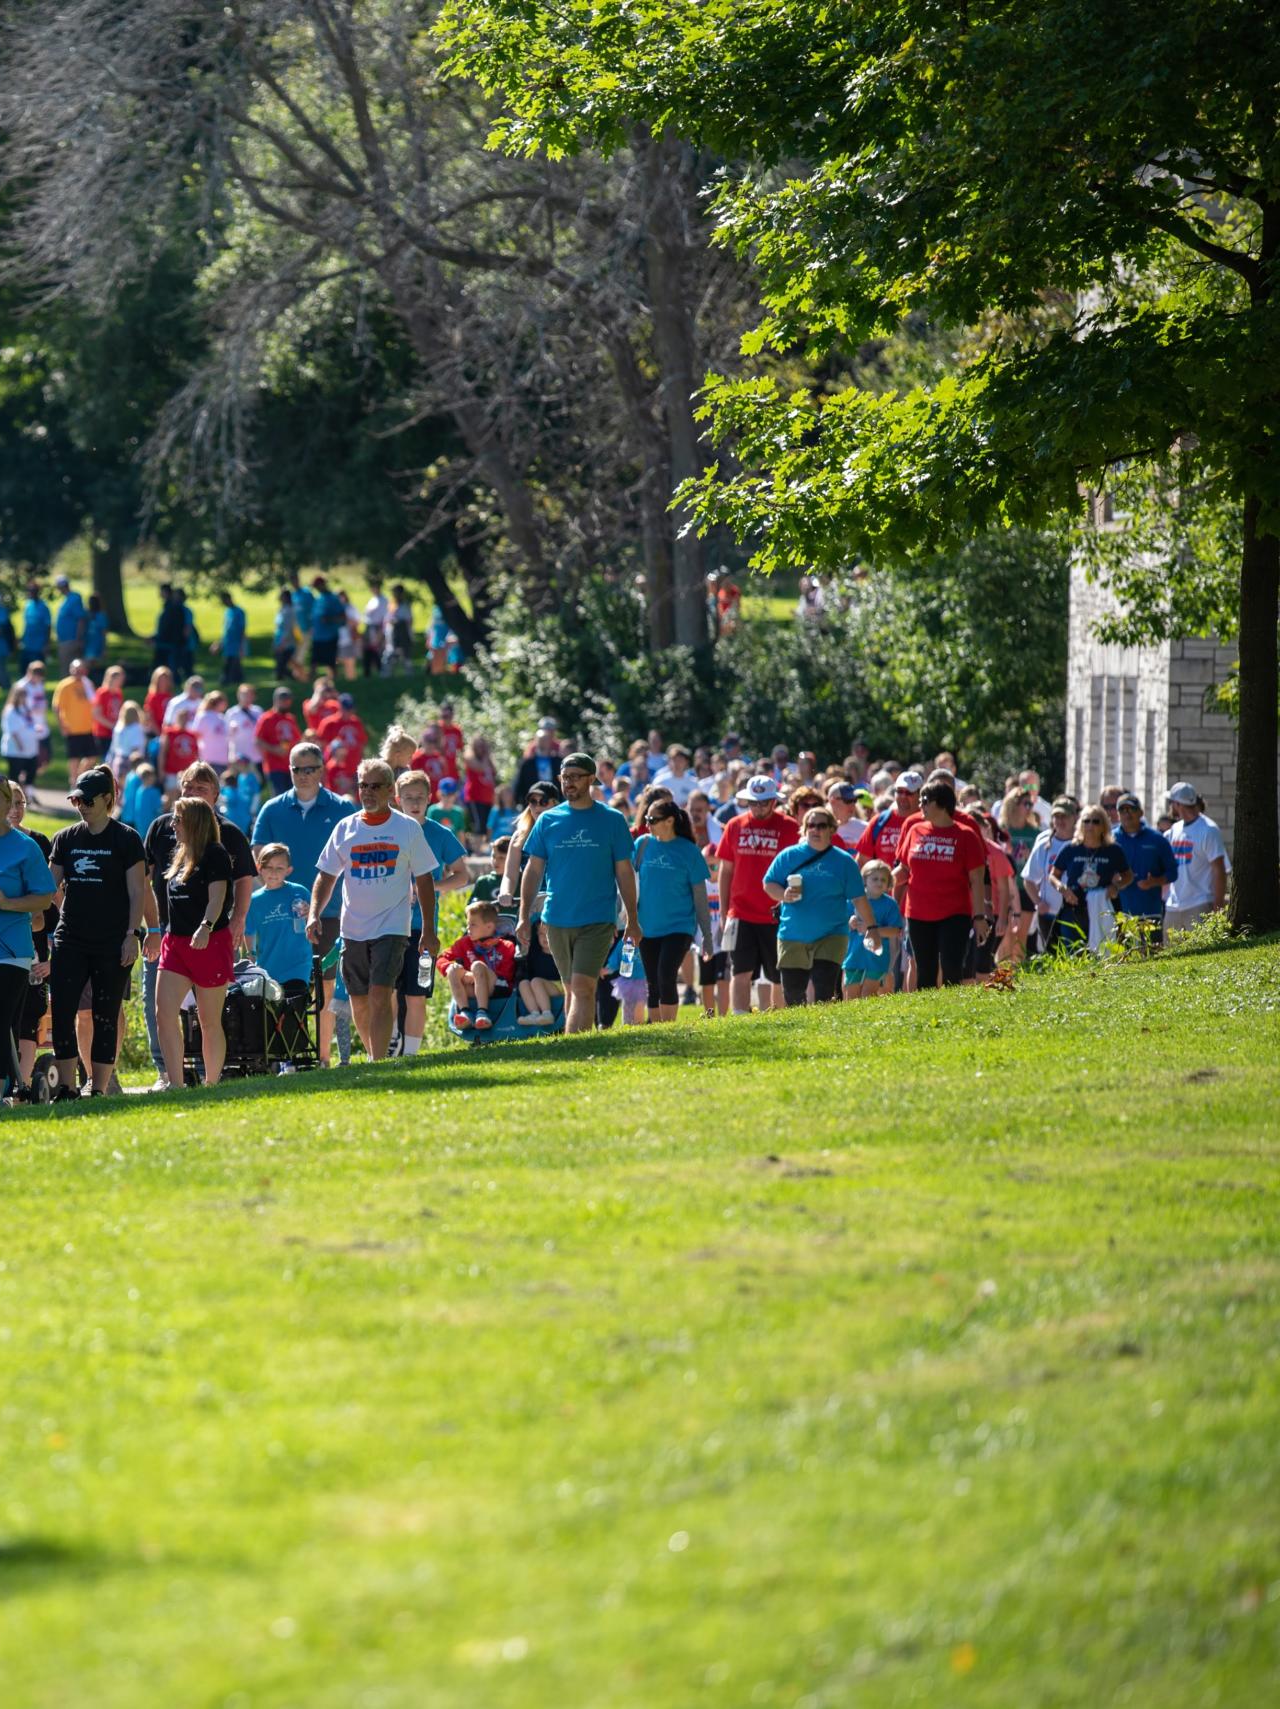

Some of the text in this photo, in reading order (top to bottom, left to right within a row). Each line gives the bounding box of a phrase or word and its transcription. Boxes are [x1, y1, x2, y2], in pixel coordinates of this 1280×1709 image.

[738, 835, 778, 849] LOVE
[918, 835, 953, 844] SOMEONE
[912, 842, 955, 855] LOVE
[359, 851, 388, 863] END
[359, 865, 388, 878] T1D
